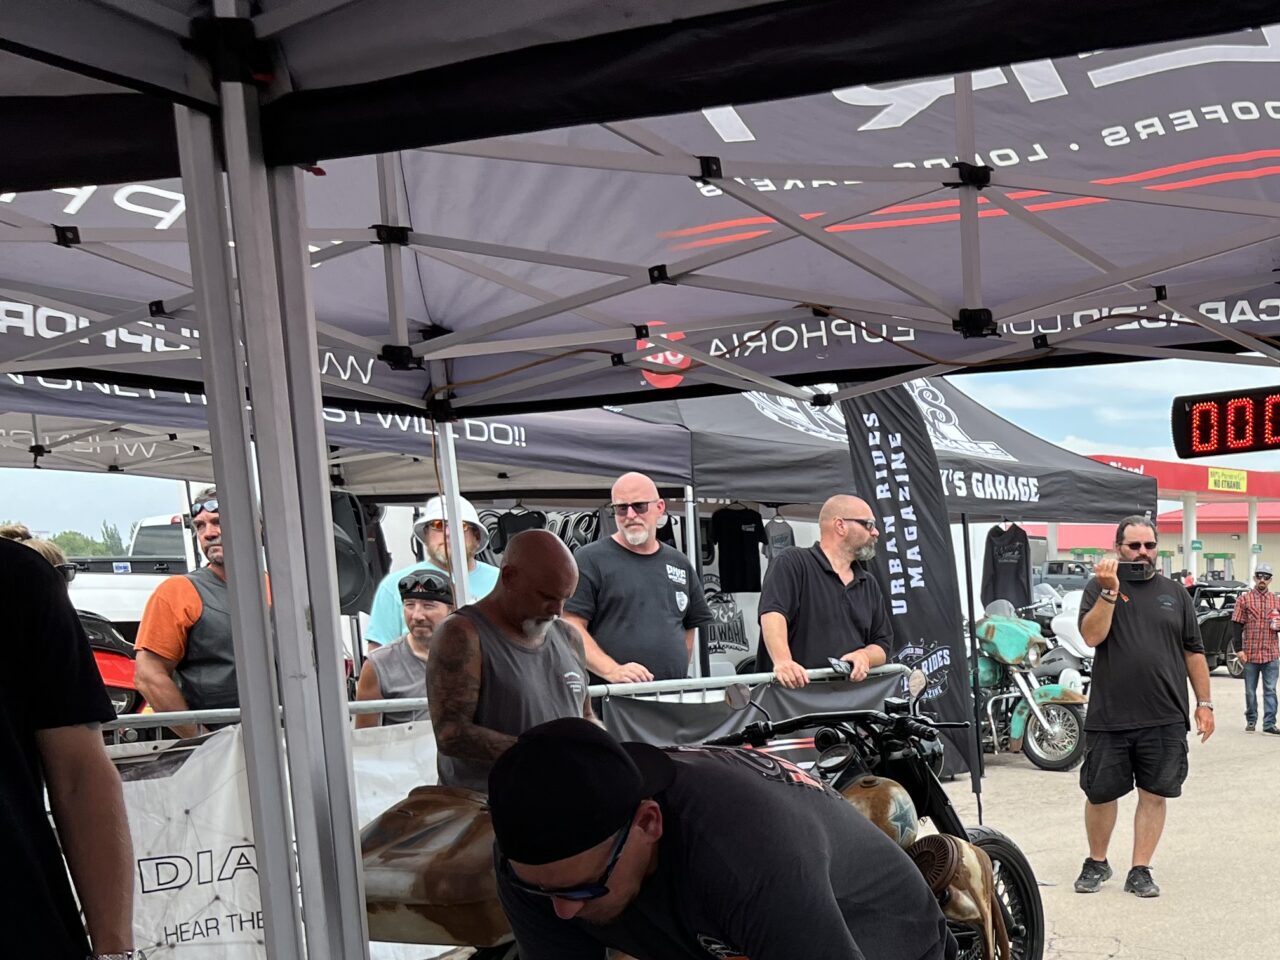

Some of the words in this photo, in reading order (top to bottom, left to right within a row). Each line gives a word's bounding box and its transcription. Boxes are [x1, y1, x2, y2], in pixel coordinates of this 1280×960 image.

[465, 419, 526, 447] DO!!
[862, 411, 892, 500] RIDES
[971, 472, 1040, 502] GARAGE
[888, 432, 925, 588] MAGAZINE
[883, 515, 908, 615] URBAN
[921, 649, 951, 675] RIDES
[138, 845, 259, 894] DIA
[164, 916, 220, 944] HEAR
[226, 911, 265, 932] THE
